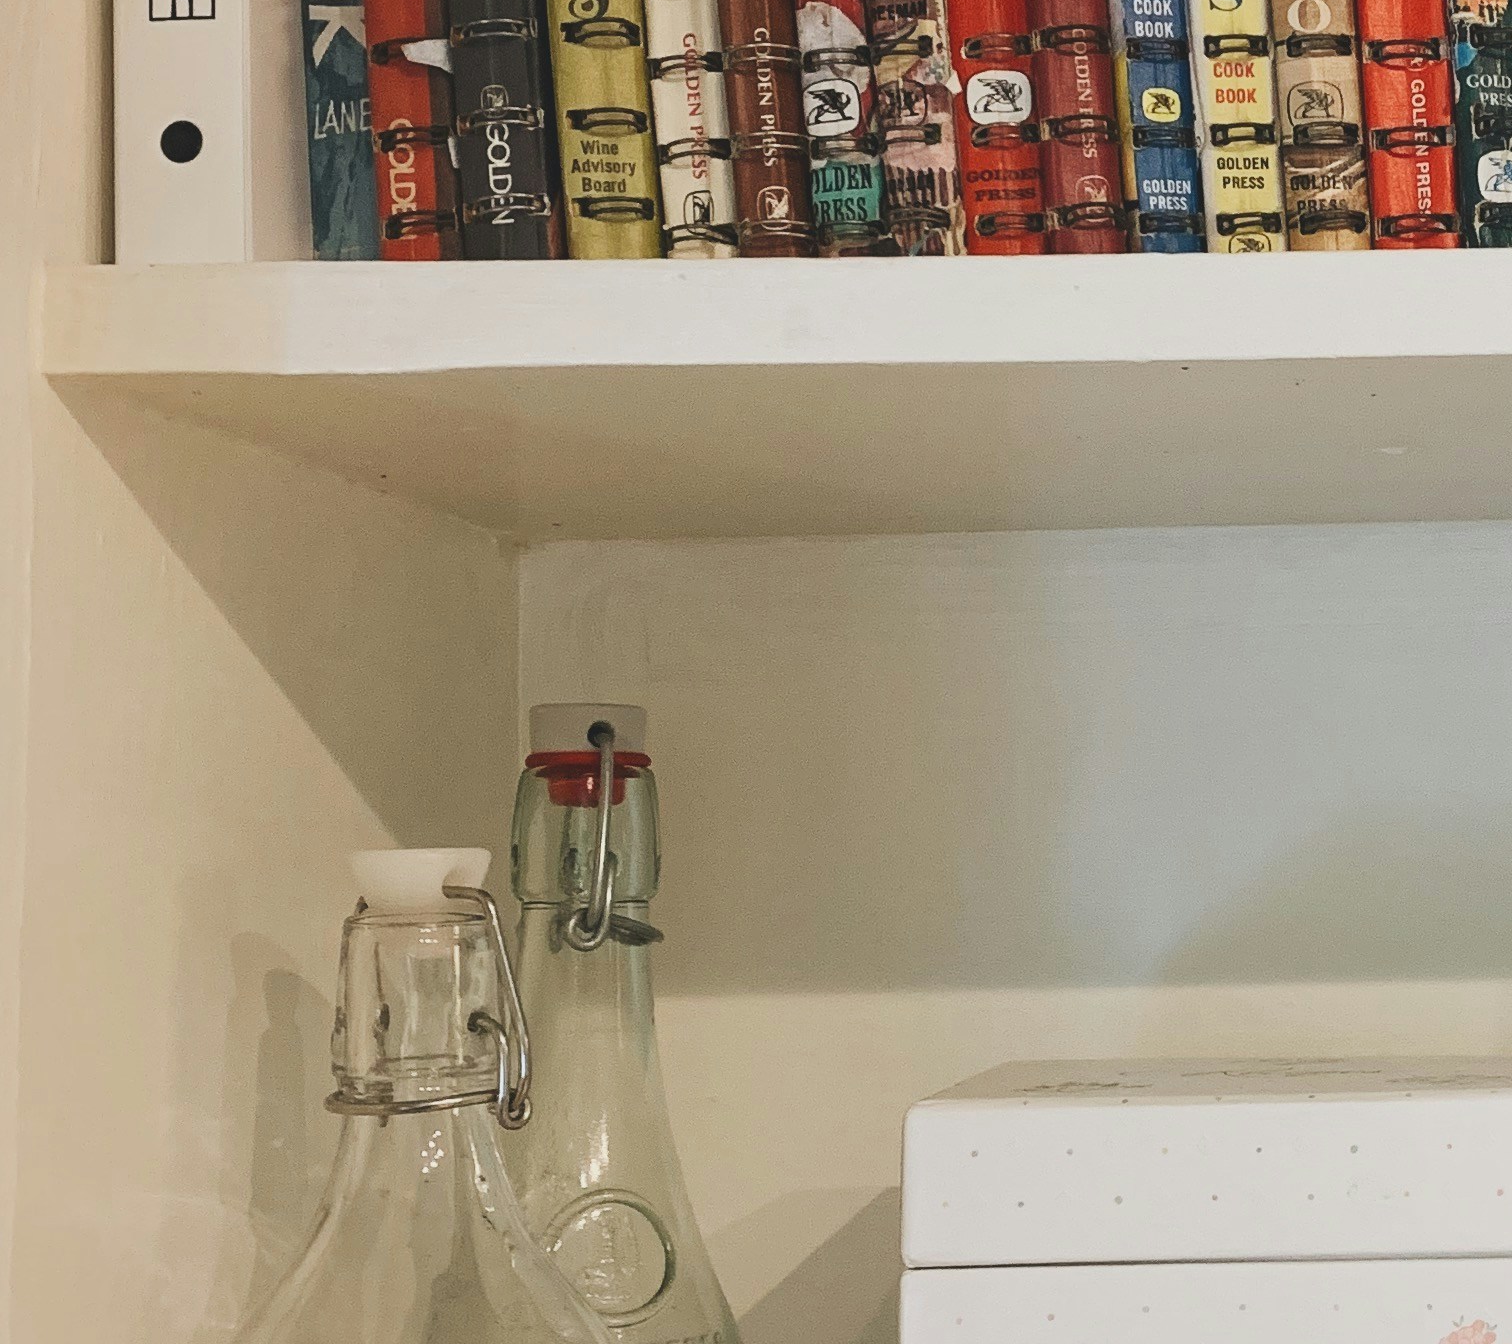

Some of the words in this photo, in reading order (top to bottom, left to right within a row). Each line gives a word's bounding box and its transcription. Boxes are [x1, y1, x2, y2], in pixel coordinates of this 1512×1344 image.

[1135, 20, 1175, 38] BOOK
[1212, 61, 1256, 79] COOK
[1215, 86, 1258, 105] BOOK
[581, 140, 619, 157] Wine
[571, 158, 636, 178] Advisory
[1216, 155, 1270, 172] GOLDEN
[485, 121, 514, 226] GOLDEN
[1222, 173, 1266, 190] PRESS
[582, 176, 627, 195] Board
[1142, 179, 1191, 196] GOLDEN
[1148, 194, 1188, 211] PRESS
